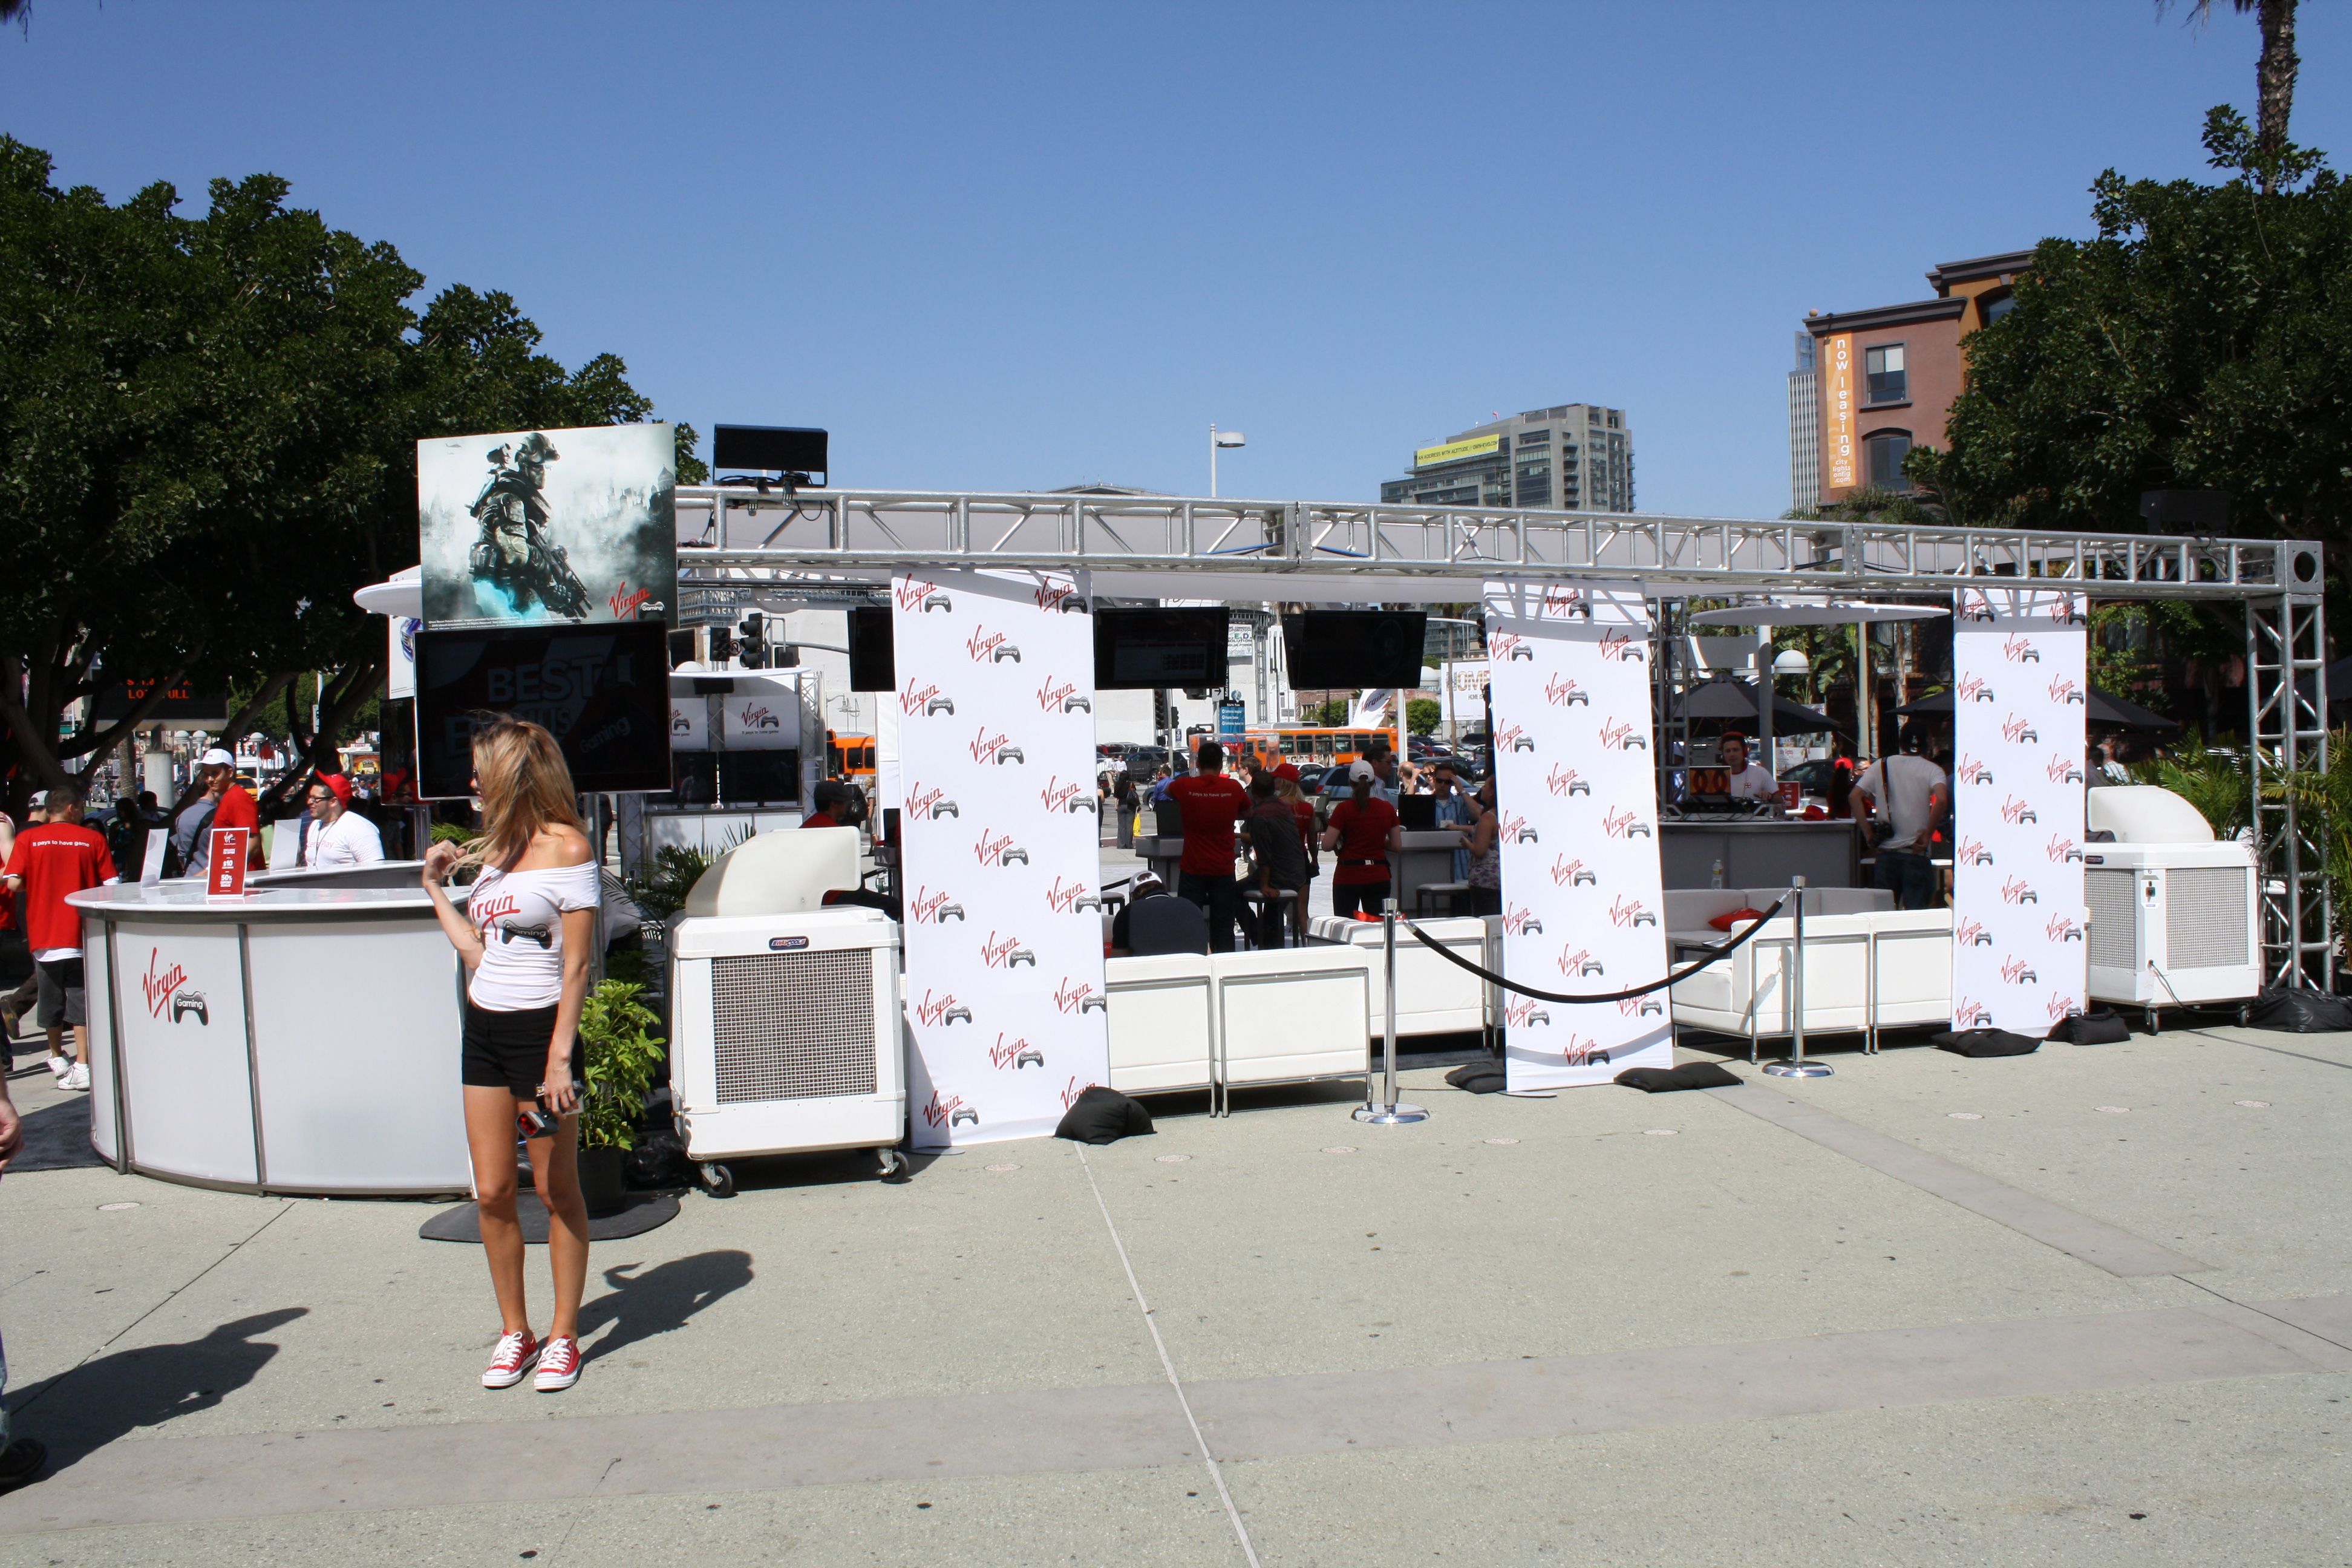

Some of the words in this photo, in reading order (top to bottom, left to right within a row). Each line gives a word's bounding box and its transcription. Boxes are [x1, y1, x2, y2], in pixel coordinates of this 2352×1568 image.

[1836, 339, 1848, 370] now
[1839, 377, 1850, 456] leasing
[609, 581, 652, 620] Virgin
[897, 573, 937, 613] Virgin
[1034, 576, 1074, 613] Virgin
[1546, 584, 1578, 616] Virgin
[1956, 592, 1985, 621] Virgin
[2050, 595, 2076, 625] Virgin
[967, 625, 1007, 663] Virgin
[1488, 626, 1521, 661] Virgin
[1598, 627, 1631, 661] Virgin
[2004, 632, 2030, 662] Virgin
[128, 689, 149, 699] LO
[486, 654, 604, 704] BEST
[1037, 675, 1076, 713] Virgin
[1544, 671, 1577, 706] Virgin
[1957, 671, 1984, 702] Virgin
[2048, 673, 2074, 704] Virgin
[900, 677, 939, 717] Virgin
[742, 702, 769, 728] Virgin
[2002, 712, 2028, 743] Virgin
[580, 716, 632, 754] Gaming
[969, 727, 1010, 765] Virgin
[1493, 718, 1523, 753] Virgin
[1599, 716, 1633, 750] Virgin
[1546, 762, 1578, 797] Virgin
[1958, 753, 1983, 785] Virgin
[2047, 753, 2073, 783] Virgin
[906, 781, 944, 820] Virgin
[1041, 775, 1081, 814] Virgin
[2001, 794, 2028, 825] Virgin
[1498, 809, 1526, 844] Virgin
[1602, 805, 1636, 839] Virgin
[975, 828, 1014, 866] Virgin
[1957, 835, 1983, 866] Virgin
[2046, 833, 2073, 863] Virgin
[1550, 853, 1583, 887] Virgin
[911, 886, 949, 924] Virgin
[1047, 875, 1086, 913] Virgin
[2001, 874, 2028, 904] Virgin
[1502, 901, 1531, 936] Virgin
[1609, 894, 1643, 928] Virgin
[2046, 912, 2072, 942] Virgin
[1956, 916, 1982, 947] Virgin
[981, 930, 1021, 969] Virgin
[1558, 944, 1590, 977] Virgin
[143, 947, 187, 1023] Virgin
[177, 998, 203, 1010] Gaming
[2001, 954, 2027, 984] Virgin
[917, 988, 956, 1027] Virgin
[1054, 976, 1093, 1014] Virgin
[1504, 993, 1537, 1028] Virgin
[1956, 996, 1982, 1027] Virgin
[2047, 991, 2073, 1019] Virgin
[989, 1032, 1029, 1070] Virgin
[1563, 1033, 1596, 1067] Virgin
[923, 1089, 964, 1128] Virgin
